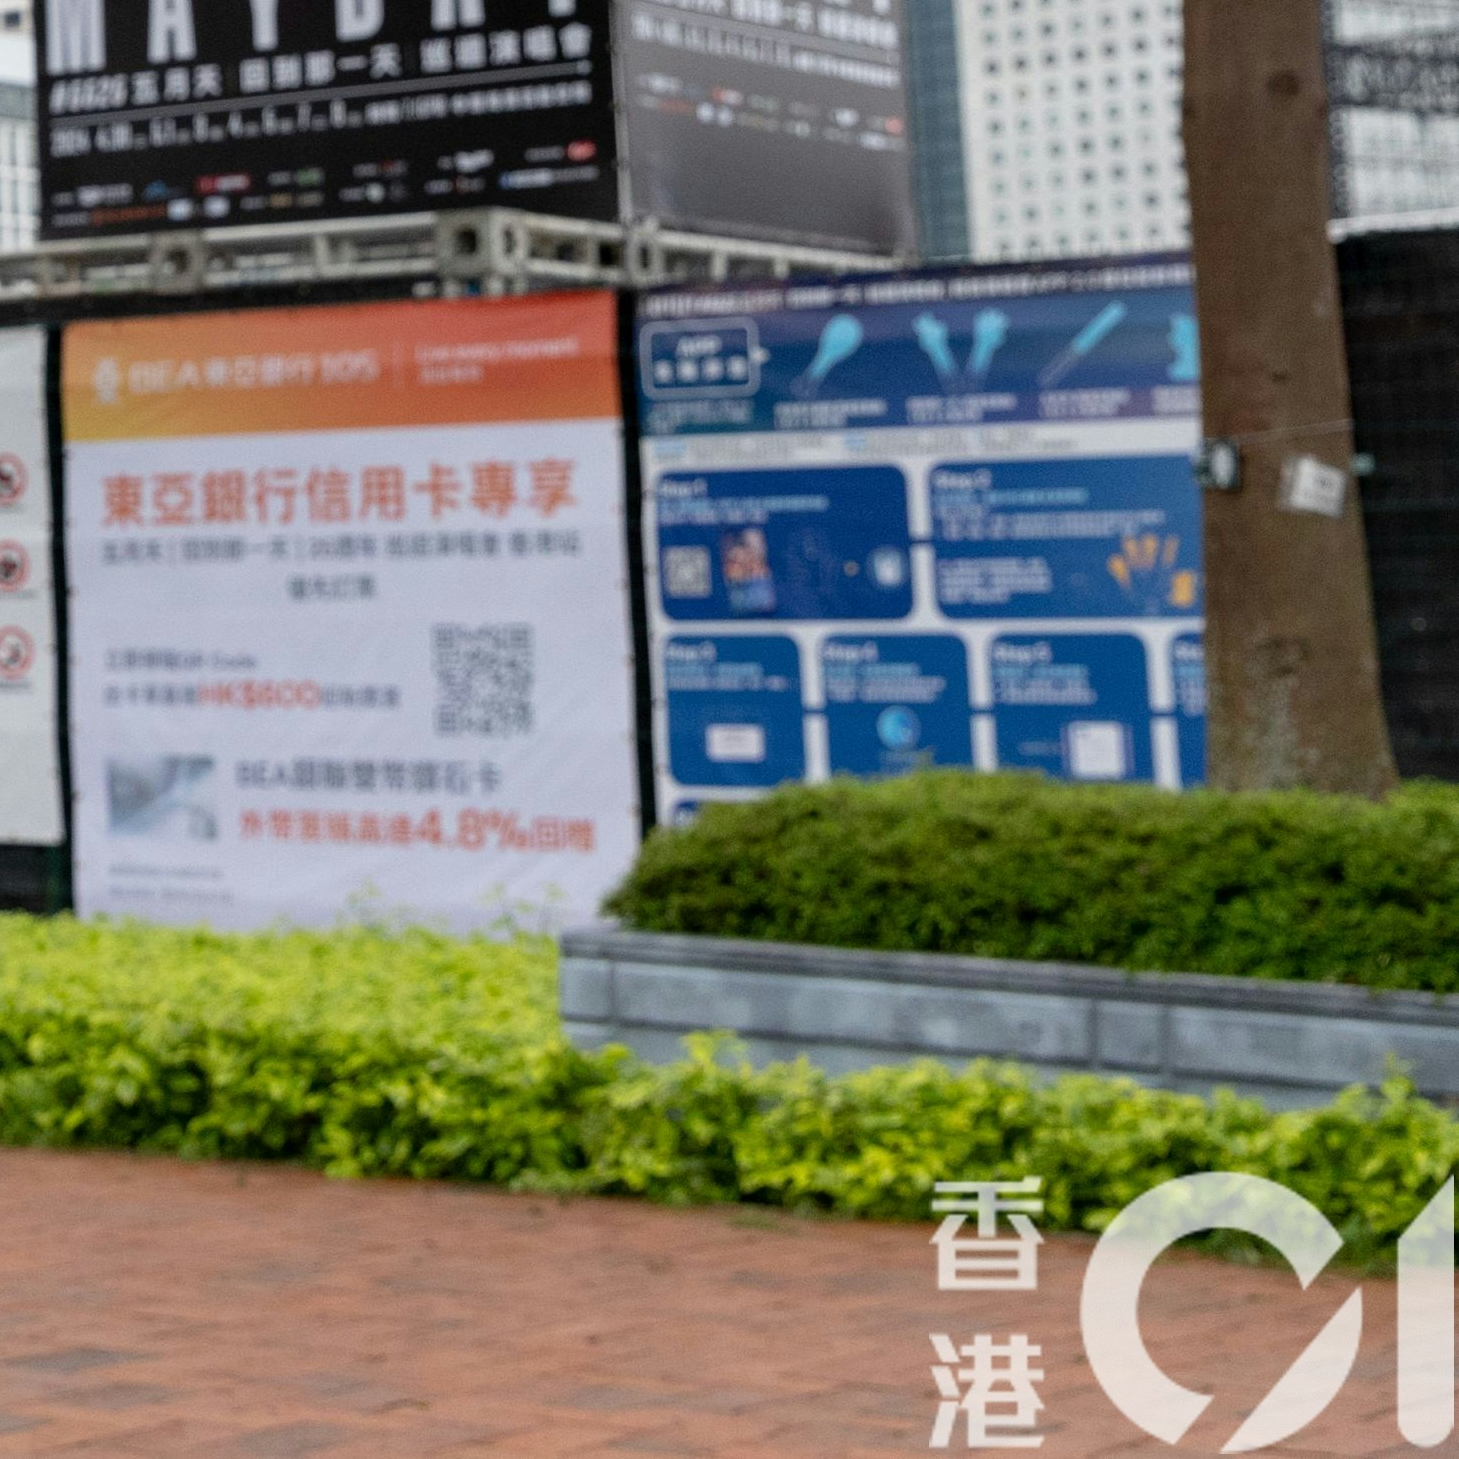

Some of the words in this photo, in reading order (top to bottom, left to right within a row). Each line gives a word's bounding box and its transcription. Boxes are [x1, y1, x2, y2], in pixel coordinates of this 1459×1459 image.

[101, 458, 576, 526] 東亞銀行信用卡專享
